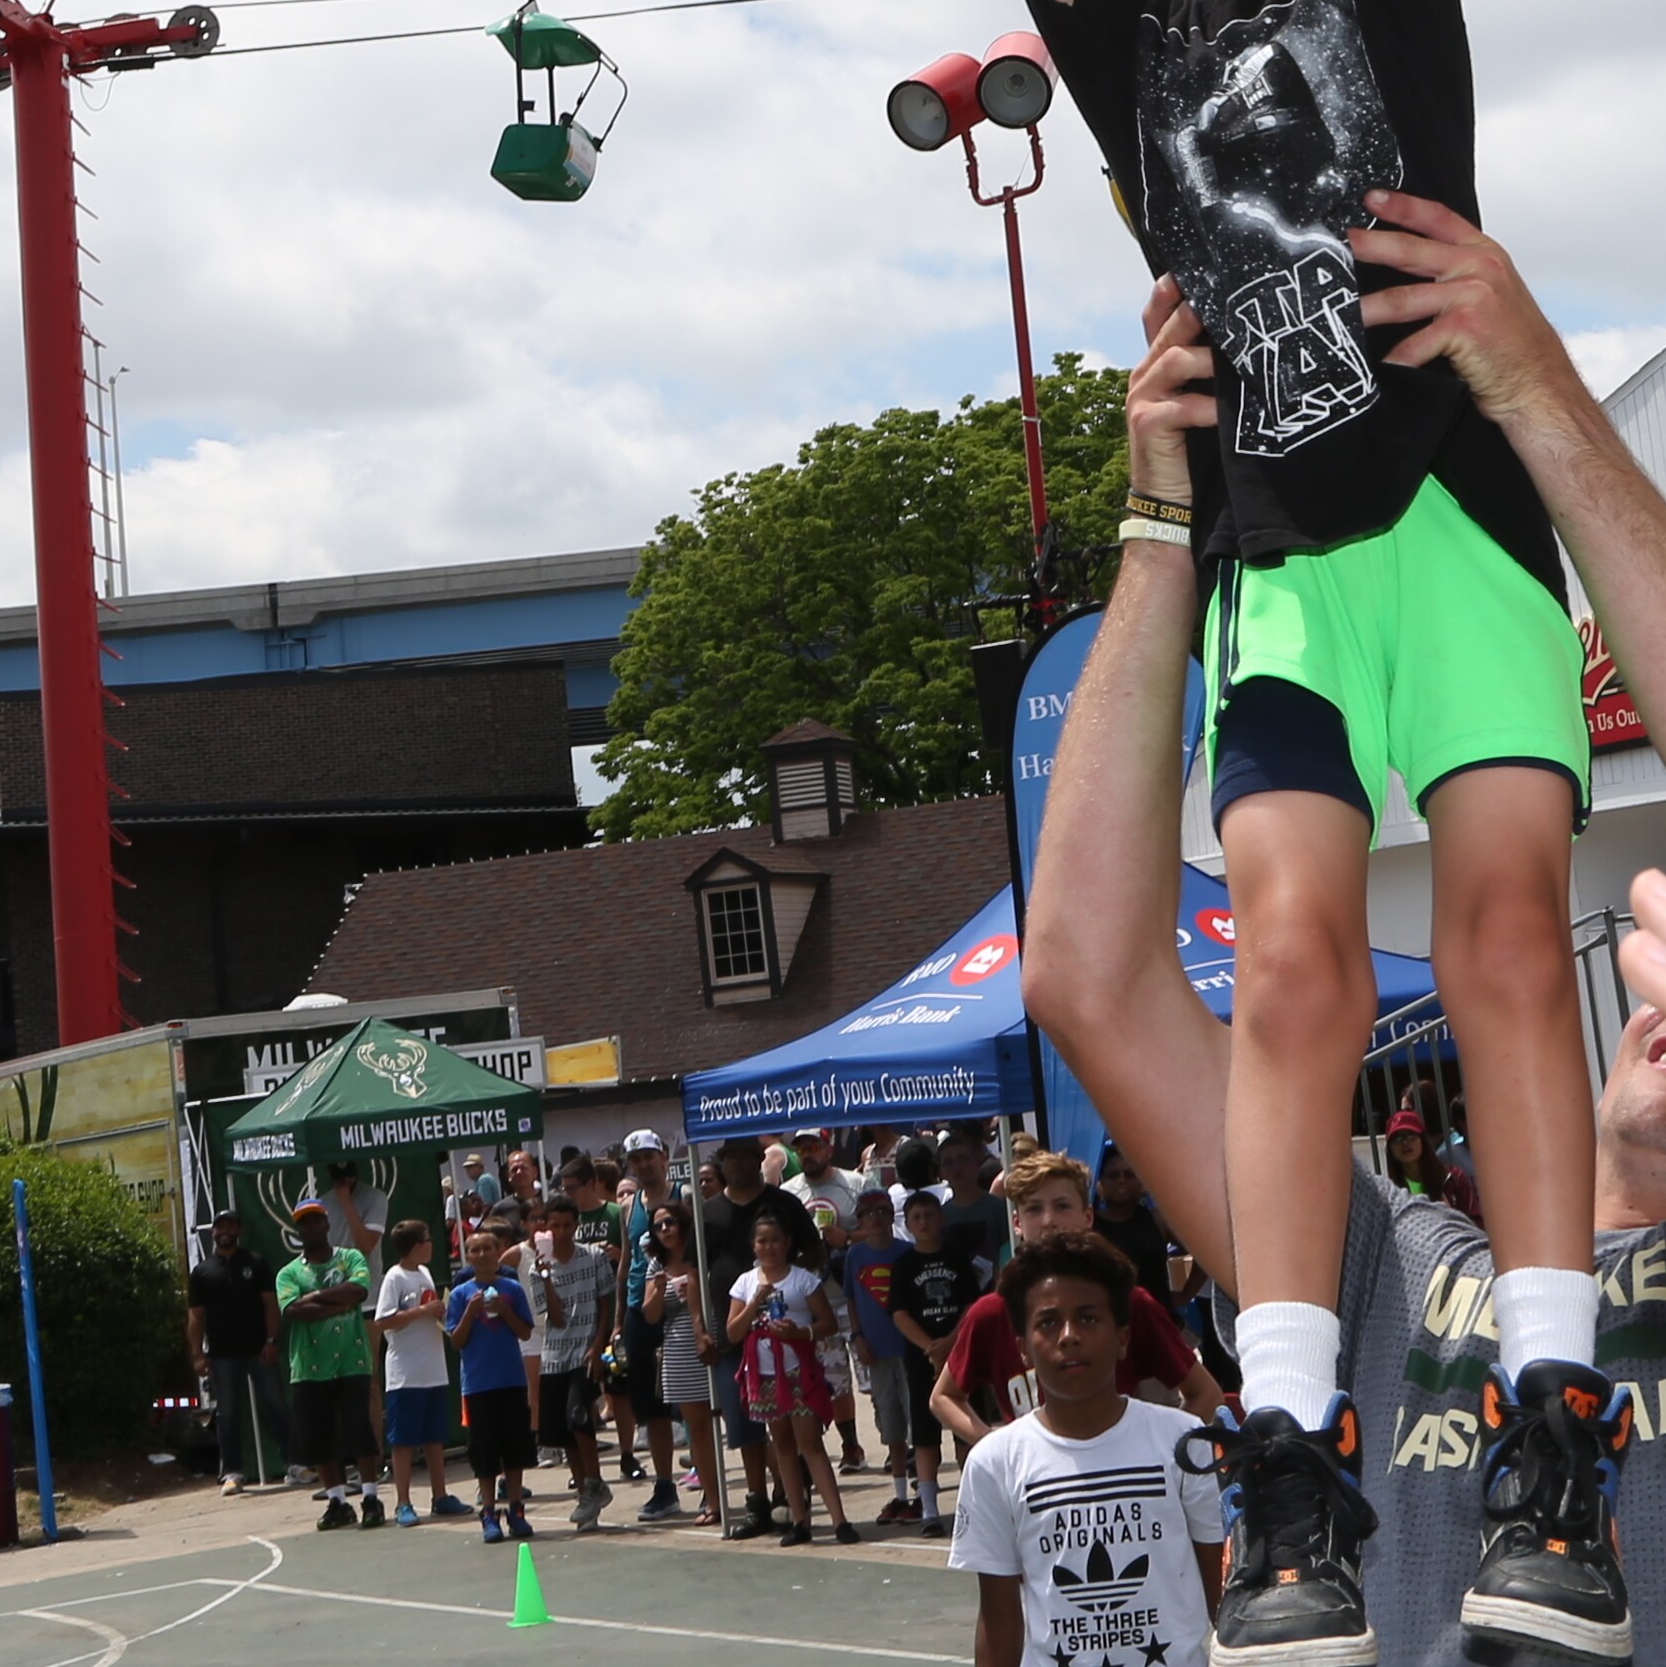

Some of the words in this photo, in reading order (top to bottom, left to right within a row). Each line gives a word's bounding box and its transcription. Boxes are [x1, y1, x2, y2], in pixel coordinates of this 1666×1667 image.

[1145, 522, 1190, 544] BUCKS
[1597, 712, 1614, 733] Us
[838, 1007, 904, 1035] Harris
[898, 1005, 962, 1025] Bank
[700, 1088, 742, 1122] Proud
[743, 1093, 761, 1116] to
[762, 1084, 783, 1115] be
[786, 1084, 818, 1119] part
[821, 1074, 837, 1107] of
[840, 1079, 877, 1113] your
[880, 1065, 975, 1104] Community
[339, 1115, 443, 1150] MILWAUKEE
[446, 1108, 508, 1135] BUCKS
[914, 1268, 957, 1286] EMERGENCY
[1055, 1502, 1142, 1531] ADIDAS
[1039, 1521, 1163, 1554] ORIGINALS
[1050, 1617, 1087, 1636] THE
[1093, 1608, 1160, 1631] THREE
[1067, 1628, 1145, 1653] STRIPES
